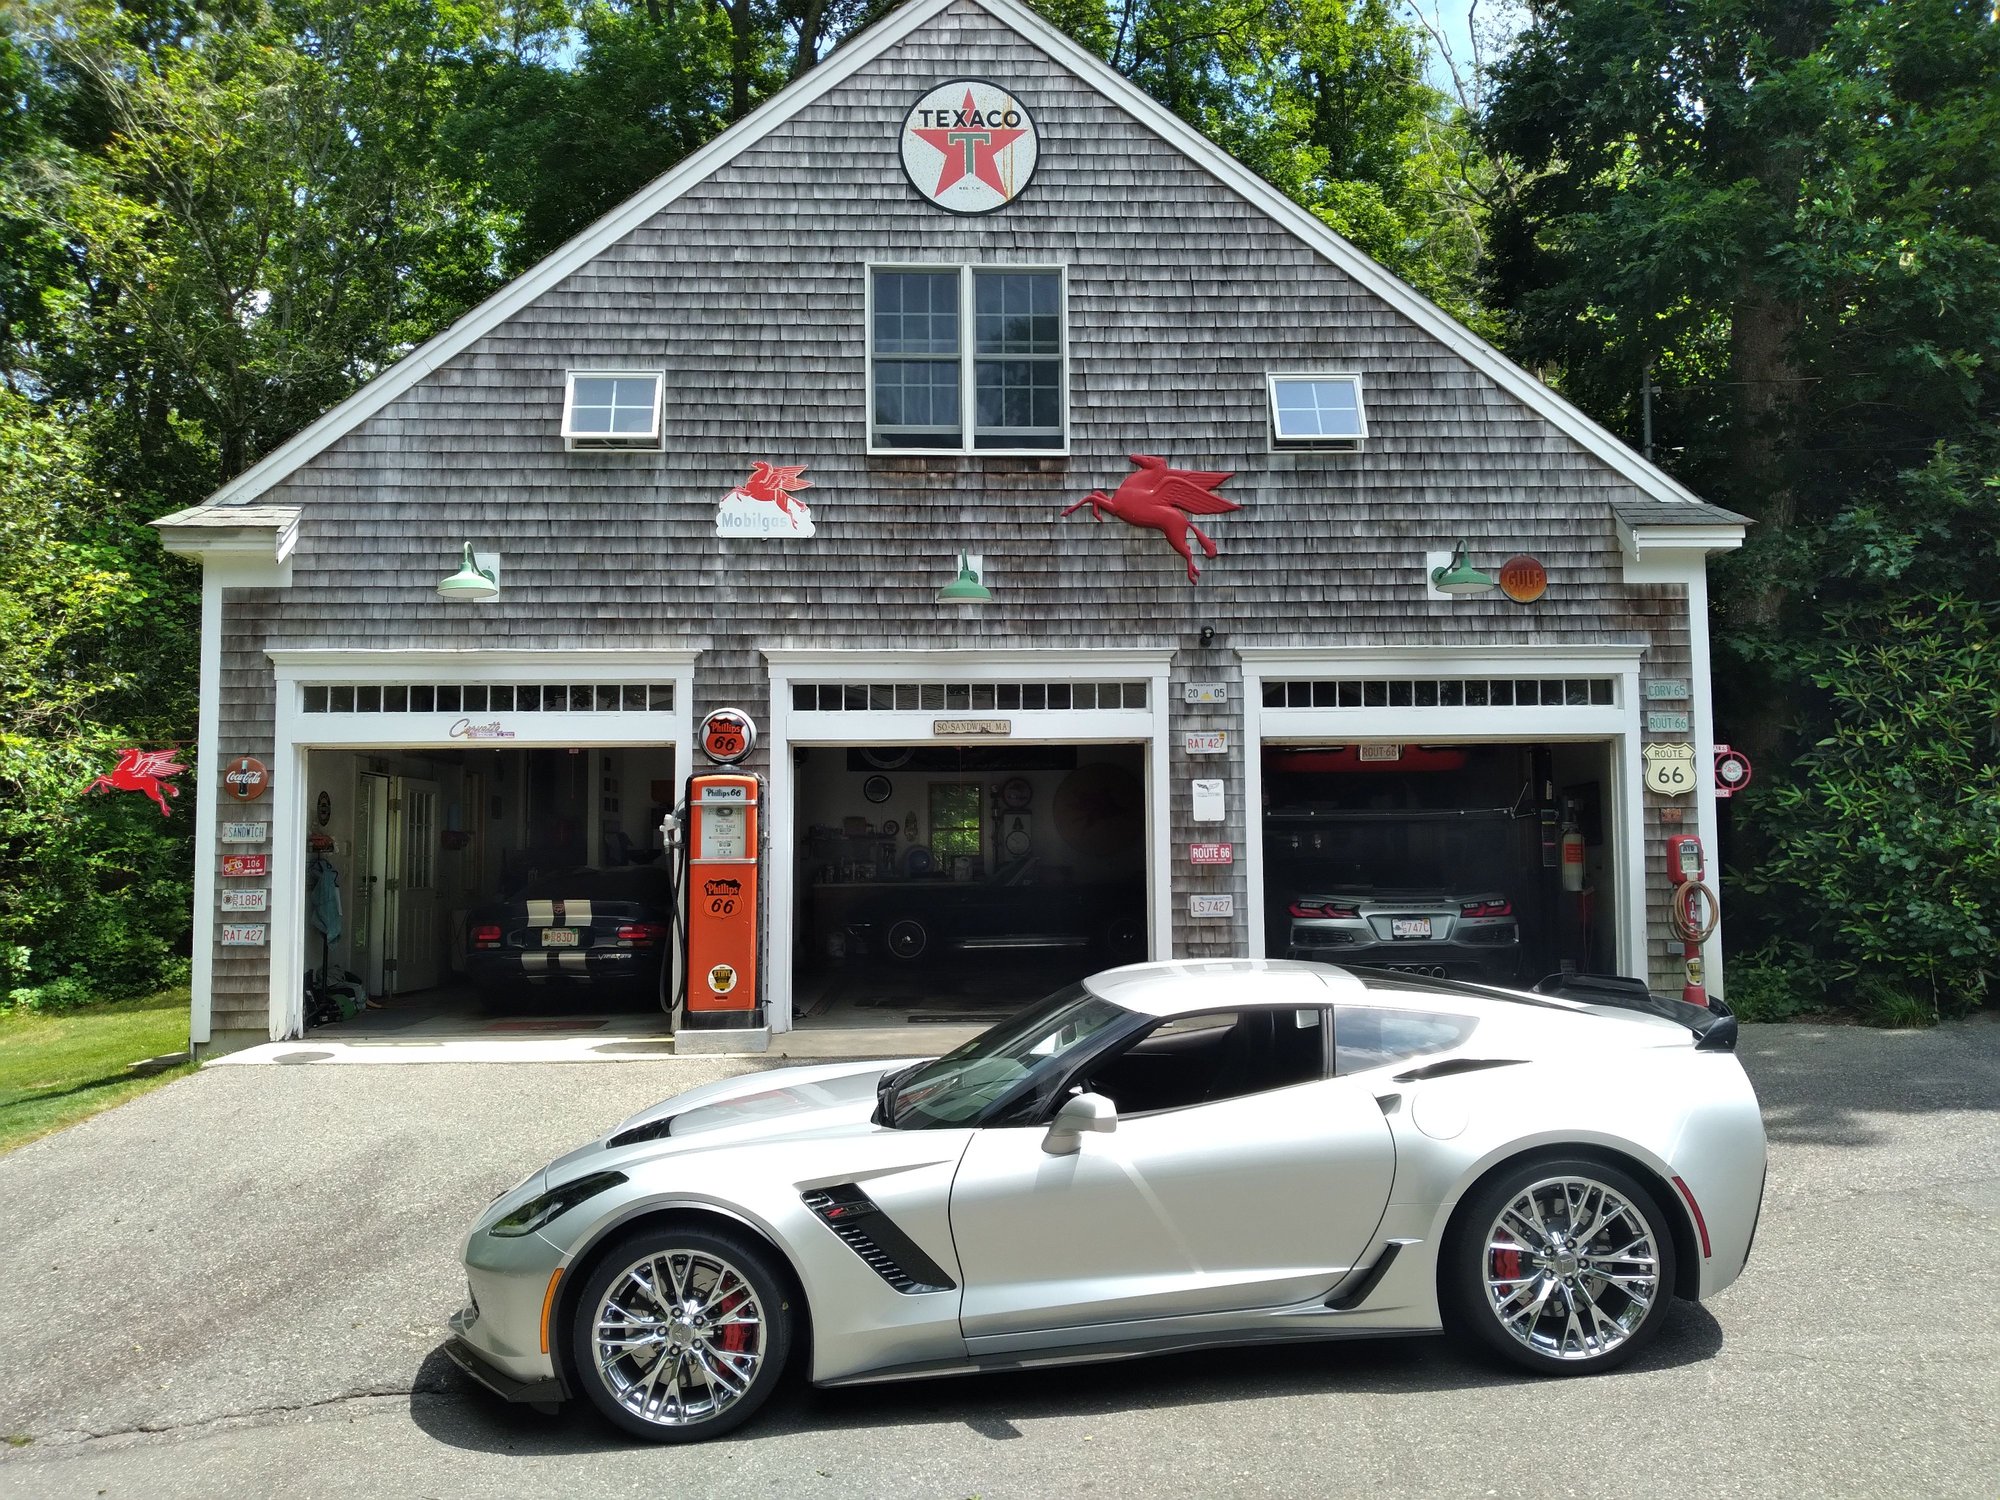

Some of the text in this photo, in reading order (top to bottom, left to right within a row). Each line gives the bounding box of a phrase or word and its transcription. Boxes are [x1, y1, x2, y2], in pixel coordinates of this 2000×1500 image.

[918, 109, 1022, 128] TEXACO
[1507, 569, 1540, 588] GULF
[1188, 688, 1225, 698] 20 05
[710, 722, 741, 734] Phillips
[714, 736, 737, 751] 66
[1188, 738, 1225, 749] RAT 427
[1654, 749, 1684, 758] ROUTE
[1658, 766, 1684, 784] 66
[706, 788, 742, 798] Phillips 66
[229, 827, 264, 838] SANDWICH
[1193, 848, 1230, 858] ROUTE 66
[247, 859, 260, 868] 106
[706, 883, 738, 896] Phillips
[239, 894, 263, 906] 18BK
[711, 898, 735, 914] 66
[223, 929, 263, 941] RAT 427
